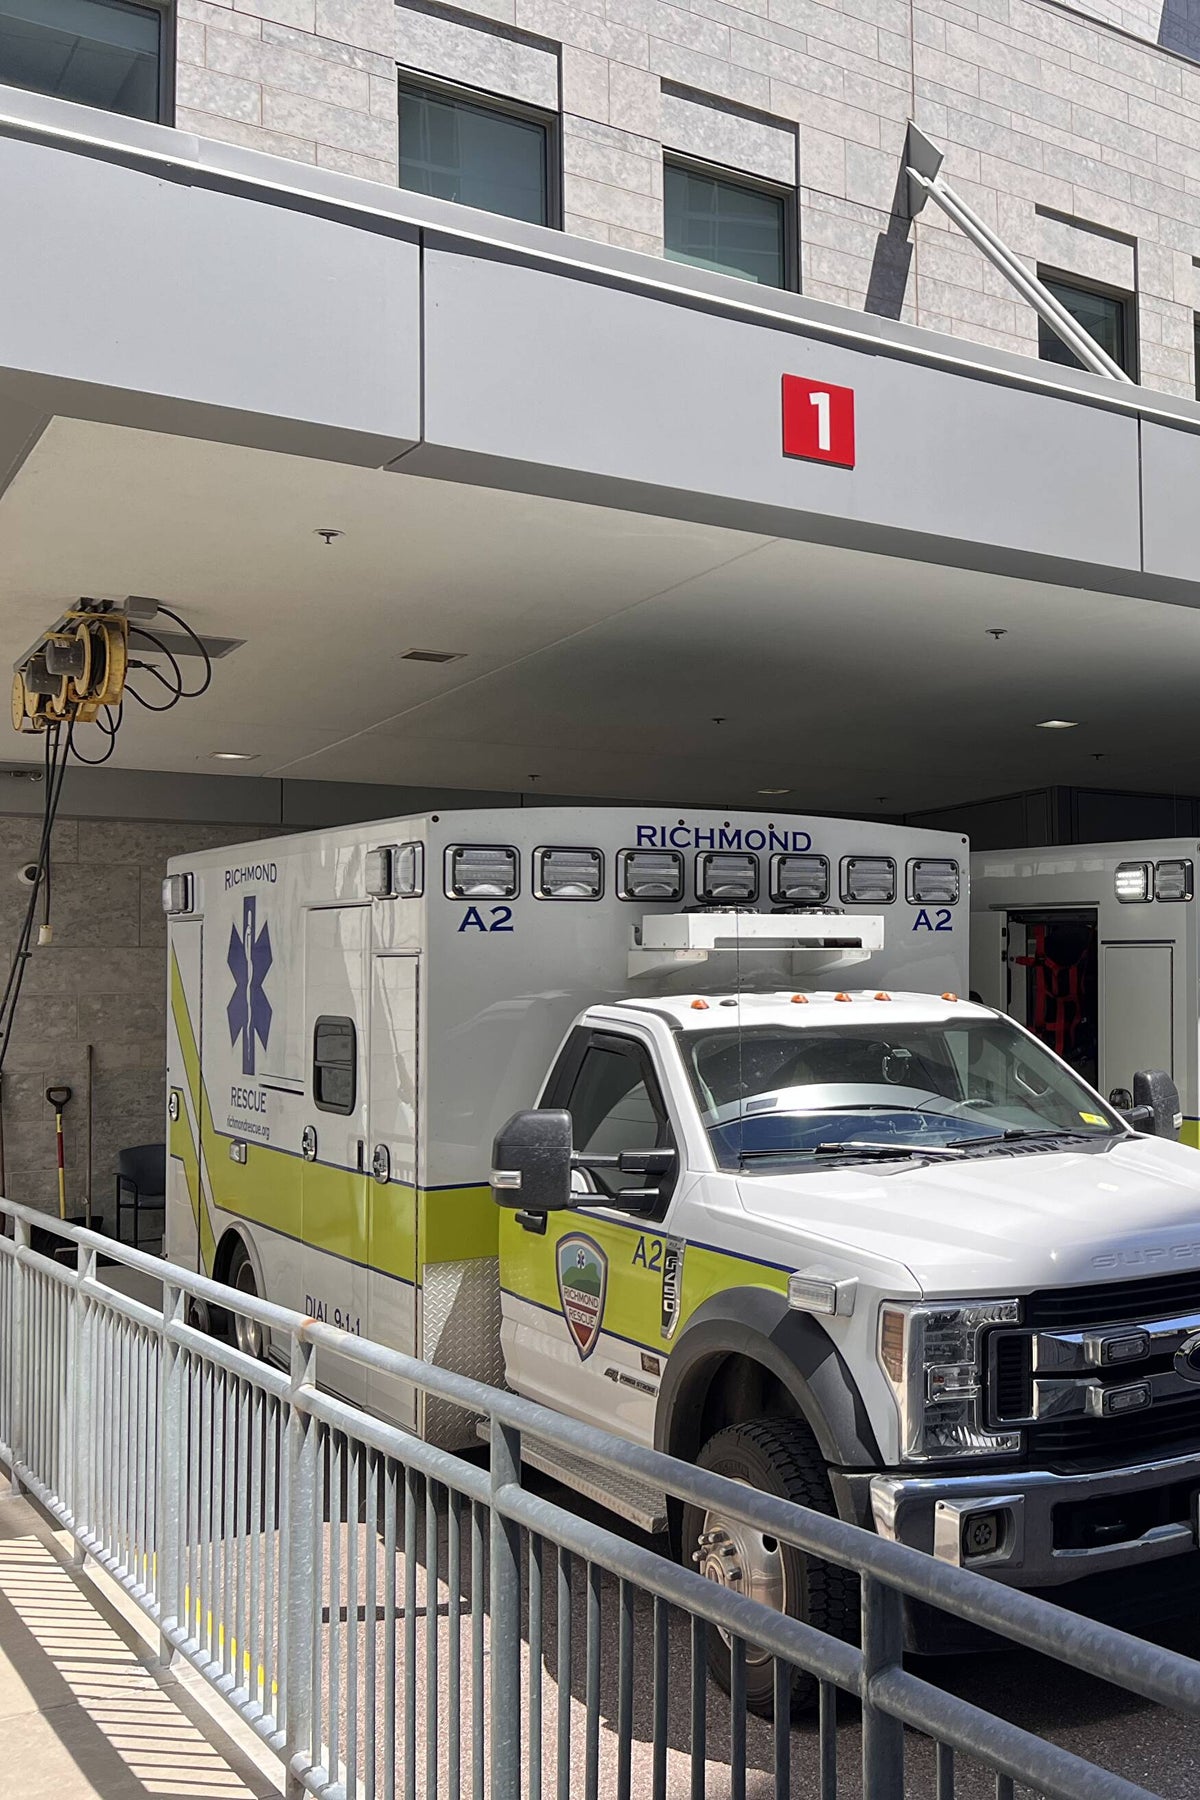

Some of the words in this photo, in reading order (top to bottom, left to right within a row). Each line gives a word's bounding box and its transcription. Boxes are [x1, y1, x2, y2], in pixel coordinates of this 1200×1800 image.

[809, 392, 830, 451] 1
[636, 825, 812, 852] RICHMOND
[225, 863, 277, 890] RICHMOND
[458, 906, 513, 932] A2
[912, 909, 952, 931] A2
[231, 1087, 266, 1113] RESCUE
[227, 1115, 270, 1140] richmondrescue.org
[632, 1236, 662, 1272] A2
[564, 1287, 599, 1308] RICHMOND
[569, 1307, 595, 1327] RESCUE
